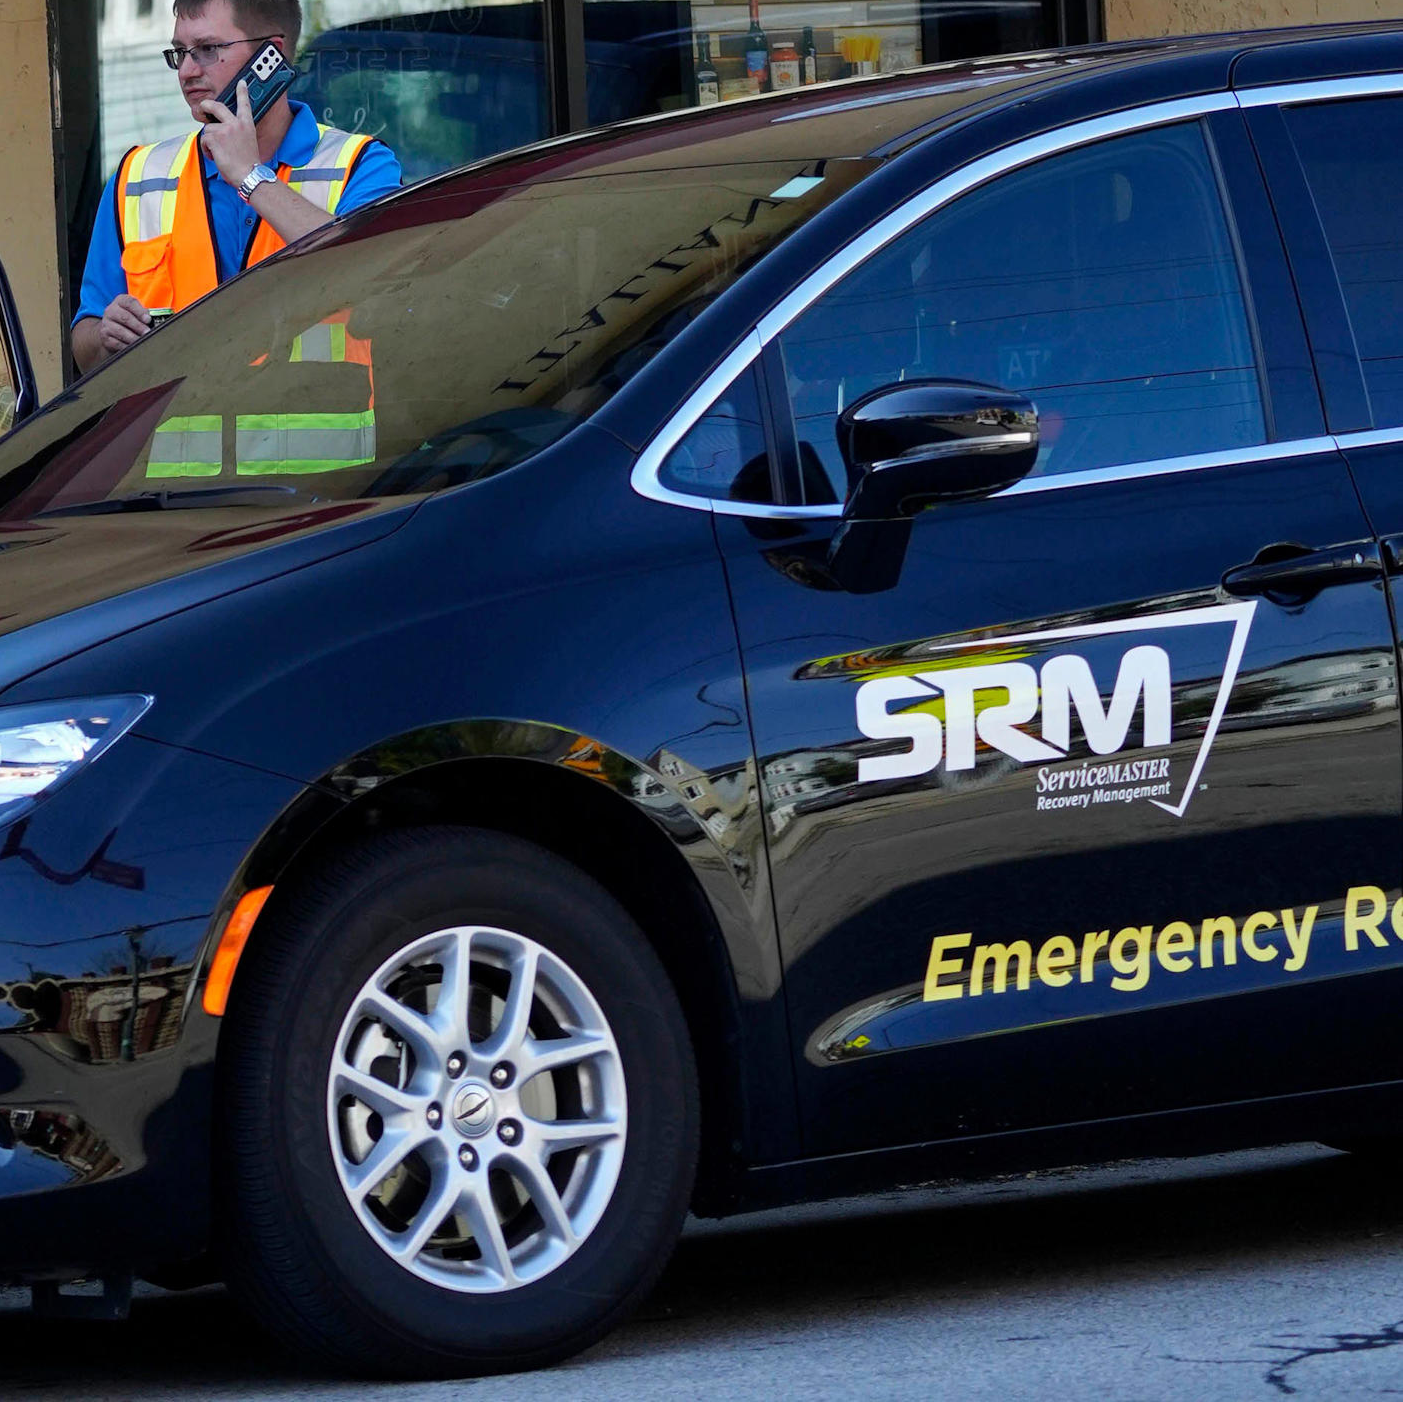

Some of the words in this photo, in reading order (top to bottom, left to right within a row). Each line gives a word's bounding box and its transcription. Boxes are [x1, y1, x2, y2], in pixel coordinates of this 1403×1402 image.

[855, 645, 1172, 782] SRM
[1036, 757, 1171, 794] ServiceMASTER
[1036, 791, 1091, 811] Recovery
[1091, 781, 1171, 805] Management
[923, 905, 1318, 1002] Emergency
